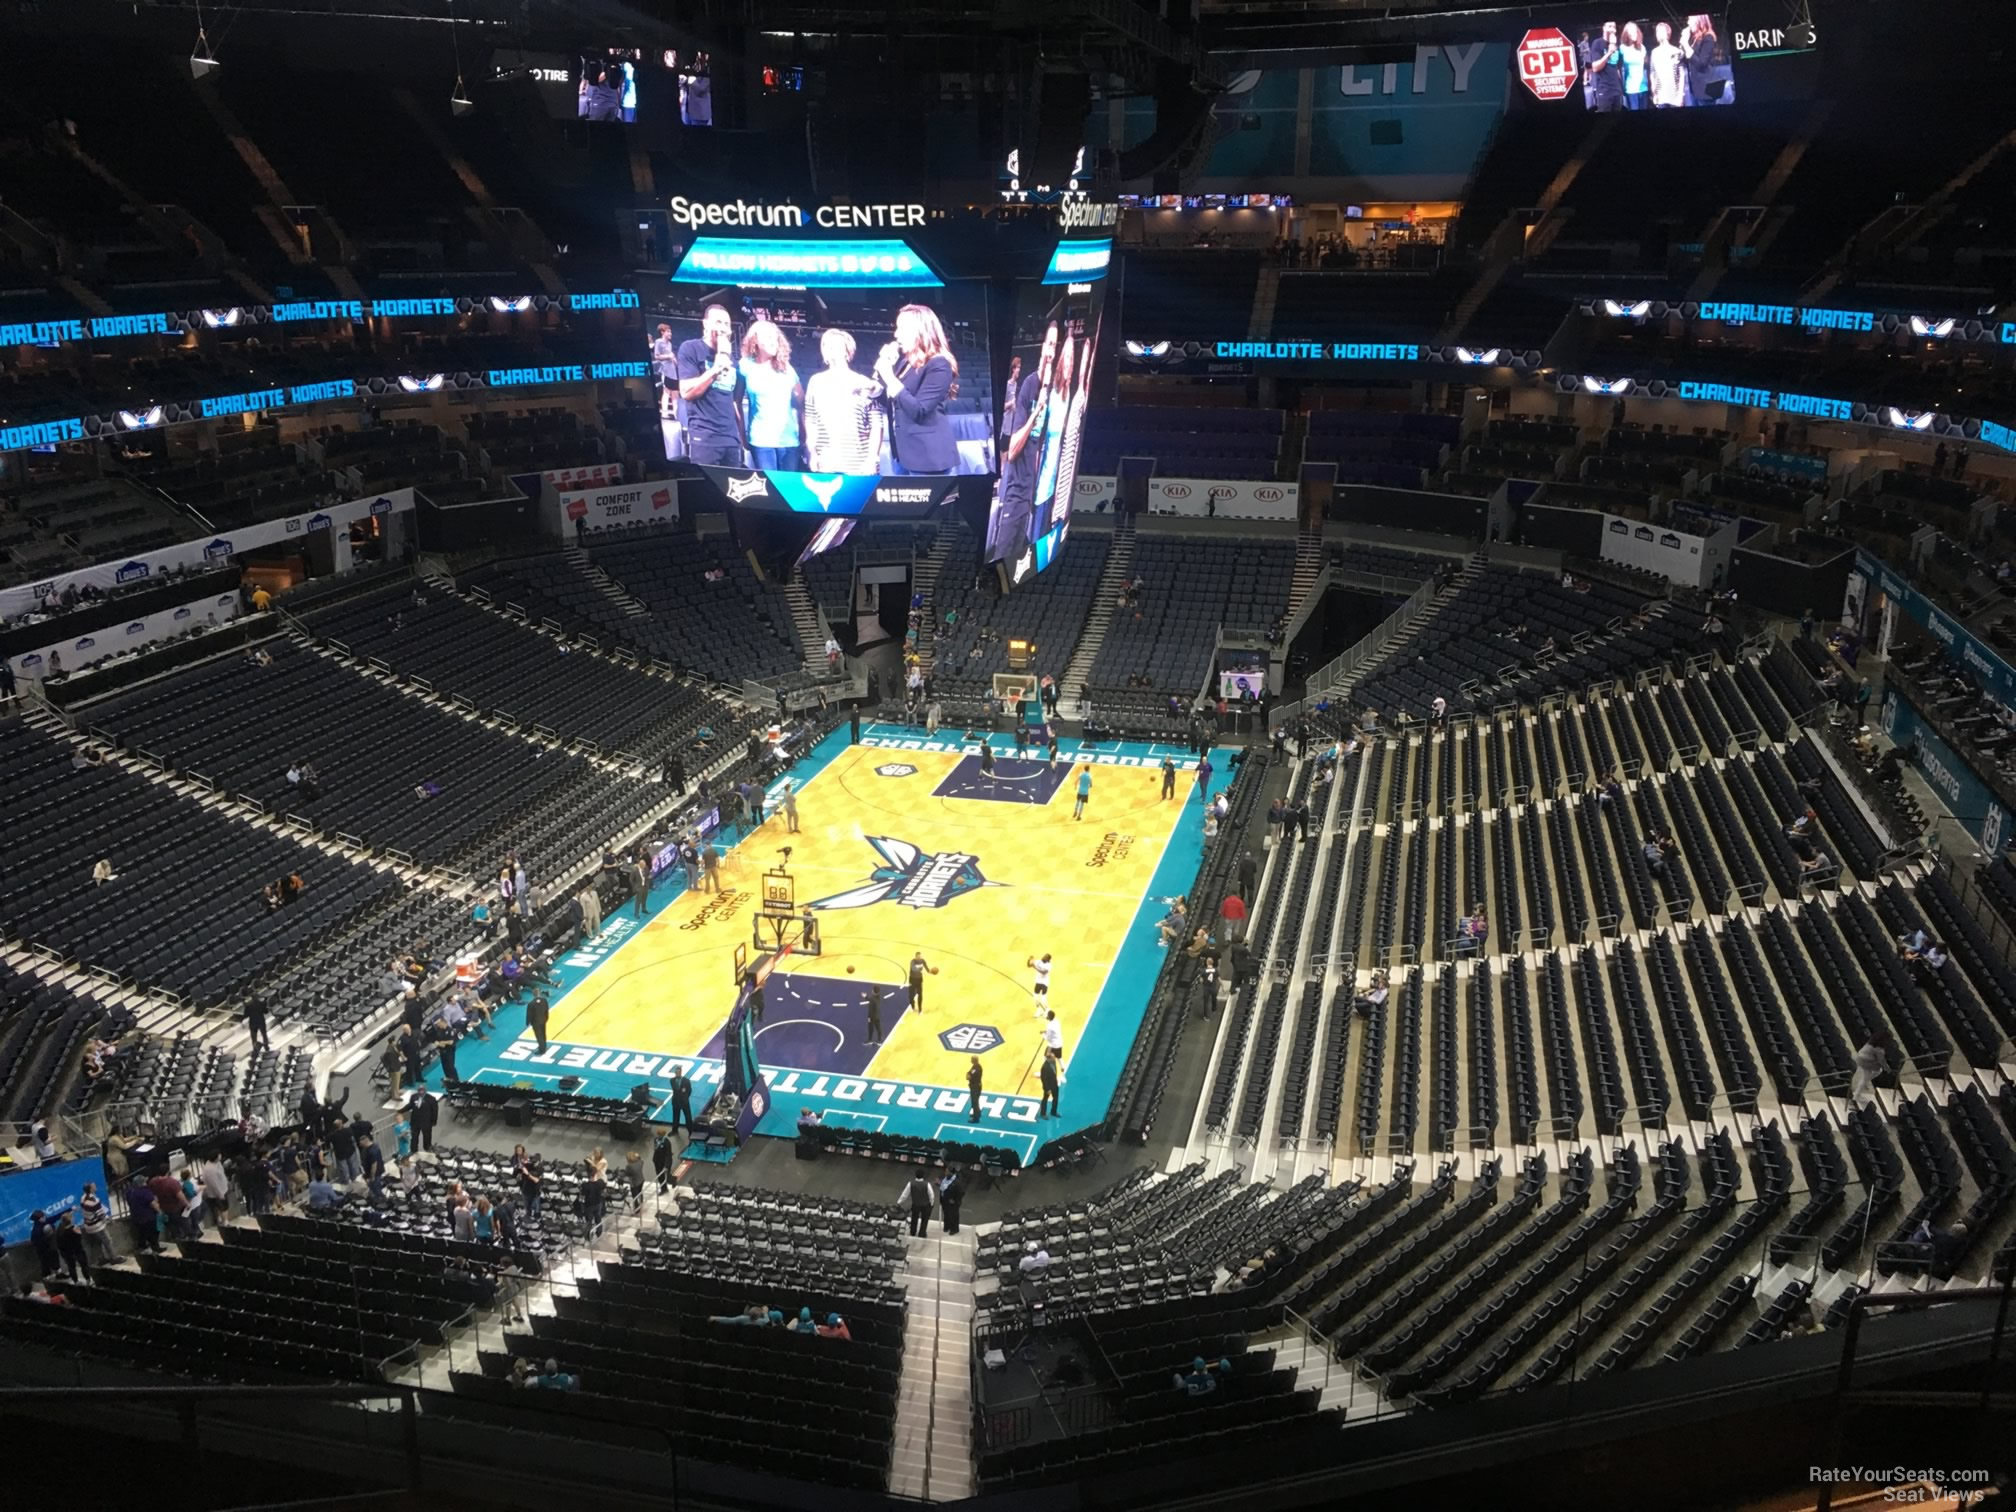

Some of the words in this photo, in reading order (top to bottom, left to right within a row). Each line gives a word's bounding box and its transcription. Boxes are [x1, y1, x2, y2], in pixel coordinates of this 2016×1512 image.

[1735, 26, 1817, 51] BARINS
[1523, 50, 1573, 75] CPI
[543, 68, 569, 82] TIRE
[1534, 77, 1566, 87] SECURITY
[1536, 85, 1567, 94] SYSTEMS
[671, 196, 802, 230] Spectrum
[816, 204, 926, 228] CENTER
[1060, 194, 1102, 234] Spectrum
[272, 300, 361, 322] CHARLOTTE
[372, 298, 454, 317] HORNETS
[1700, 302, 1793, 325] CHARLOTTE
[1801, 308, 1874, 332] HORNETS
[0, 320, 83, 347] ARLOTTE
[91, 313, 167, 338] HORNETS
[1217, 342, 1323, 358] CHARLOTTE
[1333, 343, 1419, 360] HORNETS
[489, 365, 583, 386] CHARLOTTE
[591, 362, 649, 380] HORNE
[202, 389, 284, 417] CHARLOTTE
[291, 380, 354, 402] HORNETS
[1680, 382, 1771, 408] CHARLOTTE
[1777, 393, 1852, 420] HORNETS
[596, 491, 642, 506] COMFORT
[1079, 483, 1098, 493] KIA
[1167, 486, 1187, 496] KIA
[1213, 488, 1232, 498] KIA
[1259, 490, 1278, 500] KIA
[606, 504, 631, 516] ZONE
[1085, 831, 1118, 868] Spectrum
[1112, 834, 1137, 860] CENTER
[900, 853, 971, 907] HORNETS
[680, 888, 736, 931] Spectrum
[714, 891, 754, 923] CENTER
[602, 921, 639, 949] HEALTH
